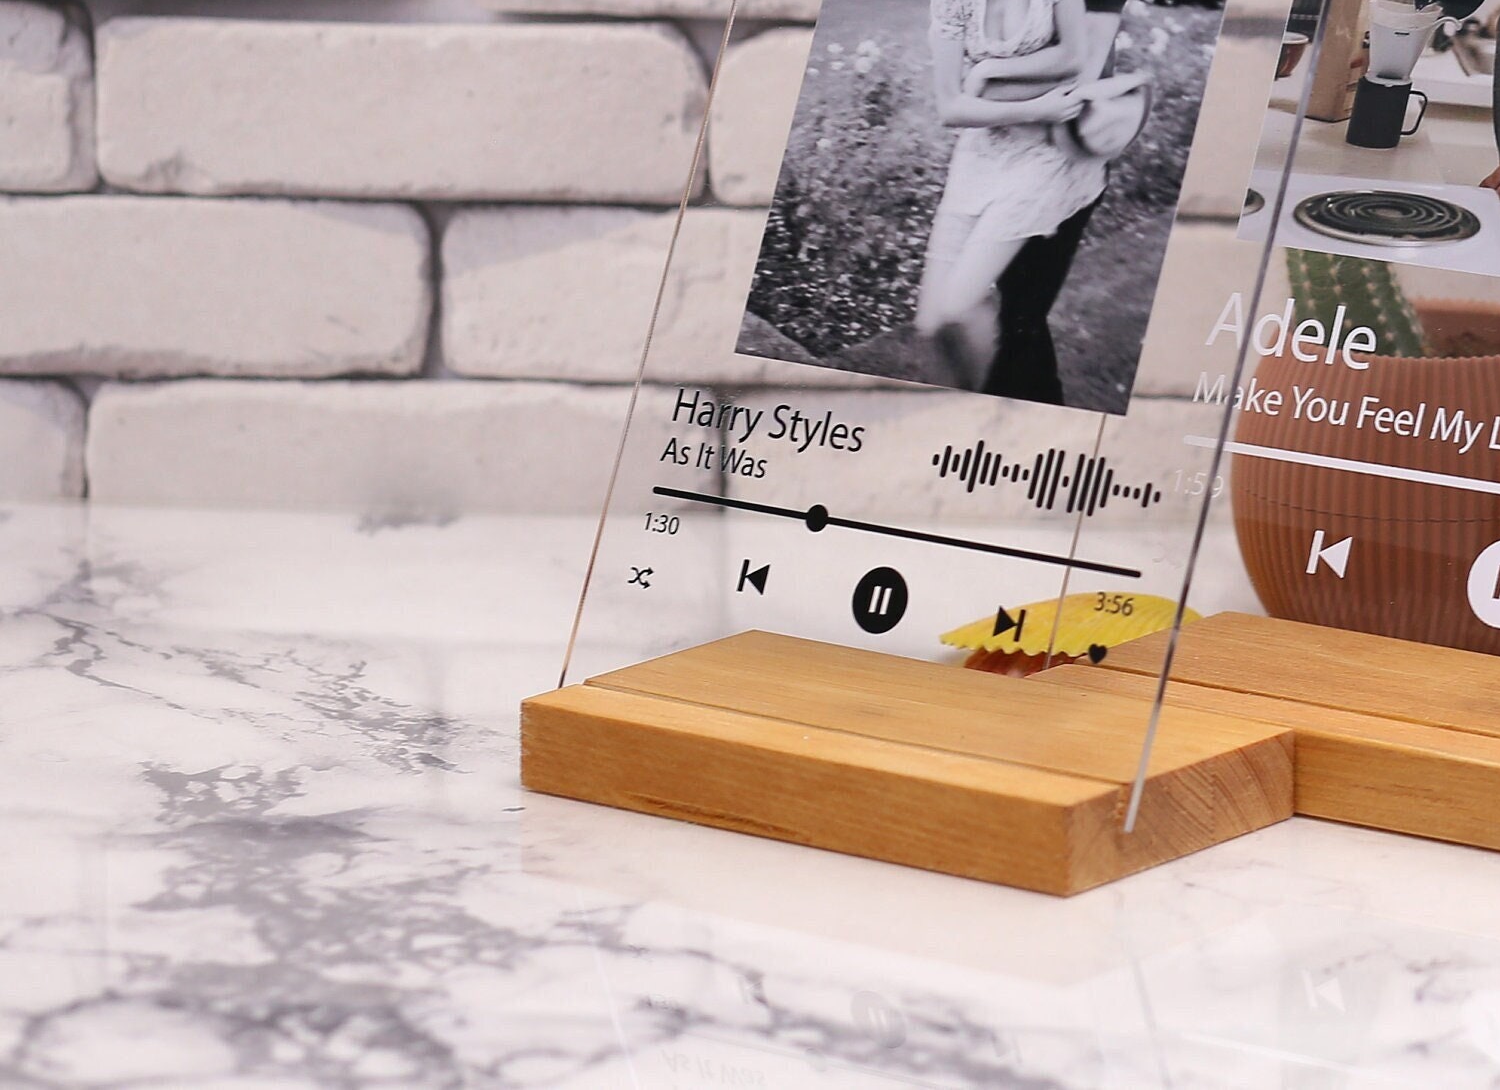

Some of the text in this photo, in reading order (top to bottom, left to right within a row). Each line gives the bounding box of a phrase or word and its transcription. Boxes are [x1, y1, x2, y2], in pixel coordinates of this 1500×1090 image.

[1204, 292, 1378, 371] Adele
[670, 388, 866, 453] Harry Styles
[1192, 371, 1284, 417] Make
[1292, 385, 1351, 427] You
[1356, 396, 1426, 439] Feel
[1430, 407, 1484, 454] My
[660, 437, 768, 479] As It Was
[1173, 468, 1225, 499] 1:59
[643, 512, 681, 536] 1:30
[1093, 591, 1135, 617] 3:56
